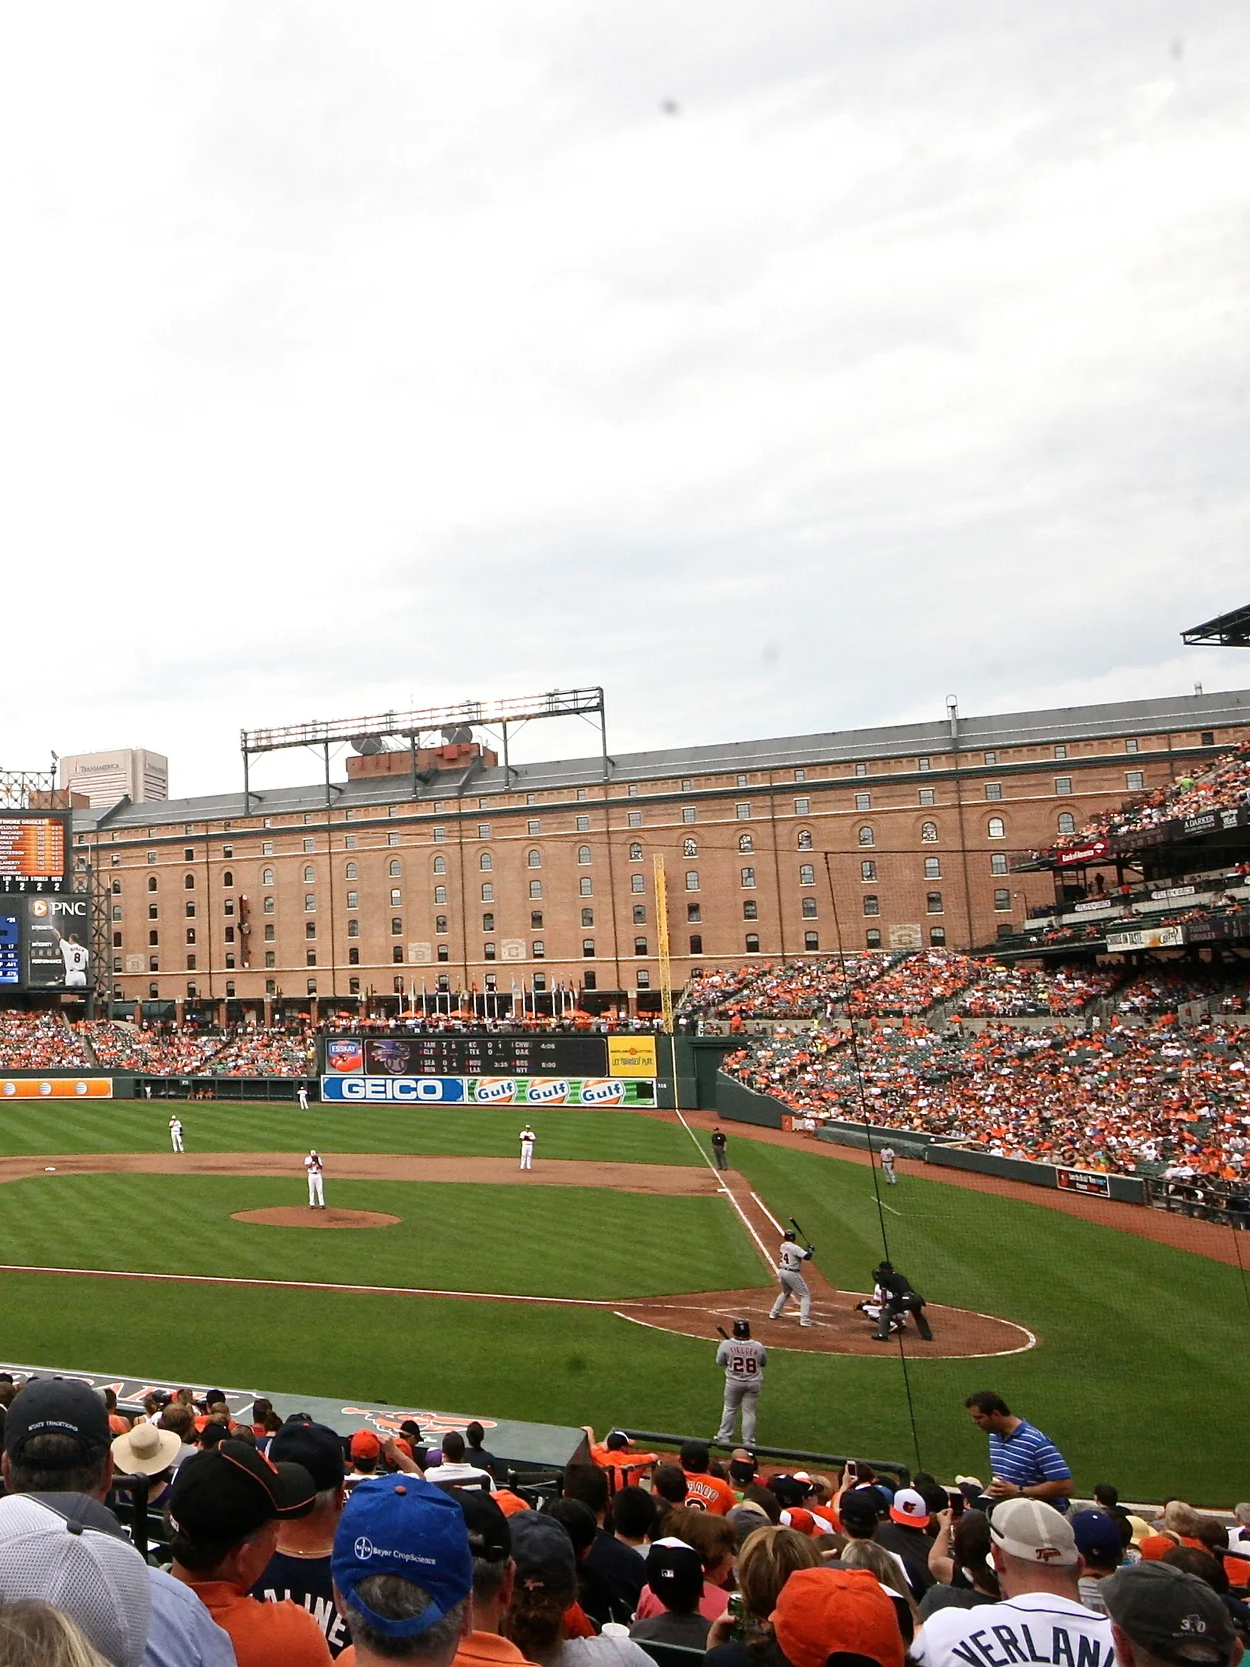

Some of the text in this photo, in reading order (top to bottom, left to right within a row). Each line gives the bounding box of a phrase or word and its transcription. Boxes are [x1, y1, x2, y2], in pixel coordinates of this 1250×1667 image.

[50, 902, 86, 916] PNC
[74, 952, 81, 963] 8
[331, 1045, 356, 1053] ESSKAY
[342, 1079, 443, 1100] GEICO
[477, 1083, 513, 1100] Gulf
[528, 1082, 566, 1101] Gulf
[582, 1083, 624, 1102] Gulf
[730, 1347, 758, 1356] FIELDER
[733, 1356, 757, 1374] 28
[28, 1420, 78, 1432] STATE TRADITIONS
[687, 1481, 719, 1502] HADO
[373, 1547, 436, 1565] Bayer CropScience
[951, 1624, 1115, 1667] VERLAN
